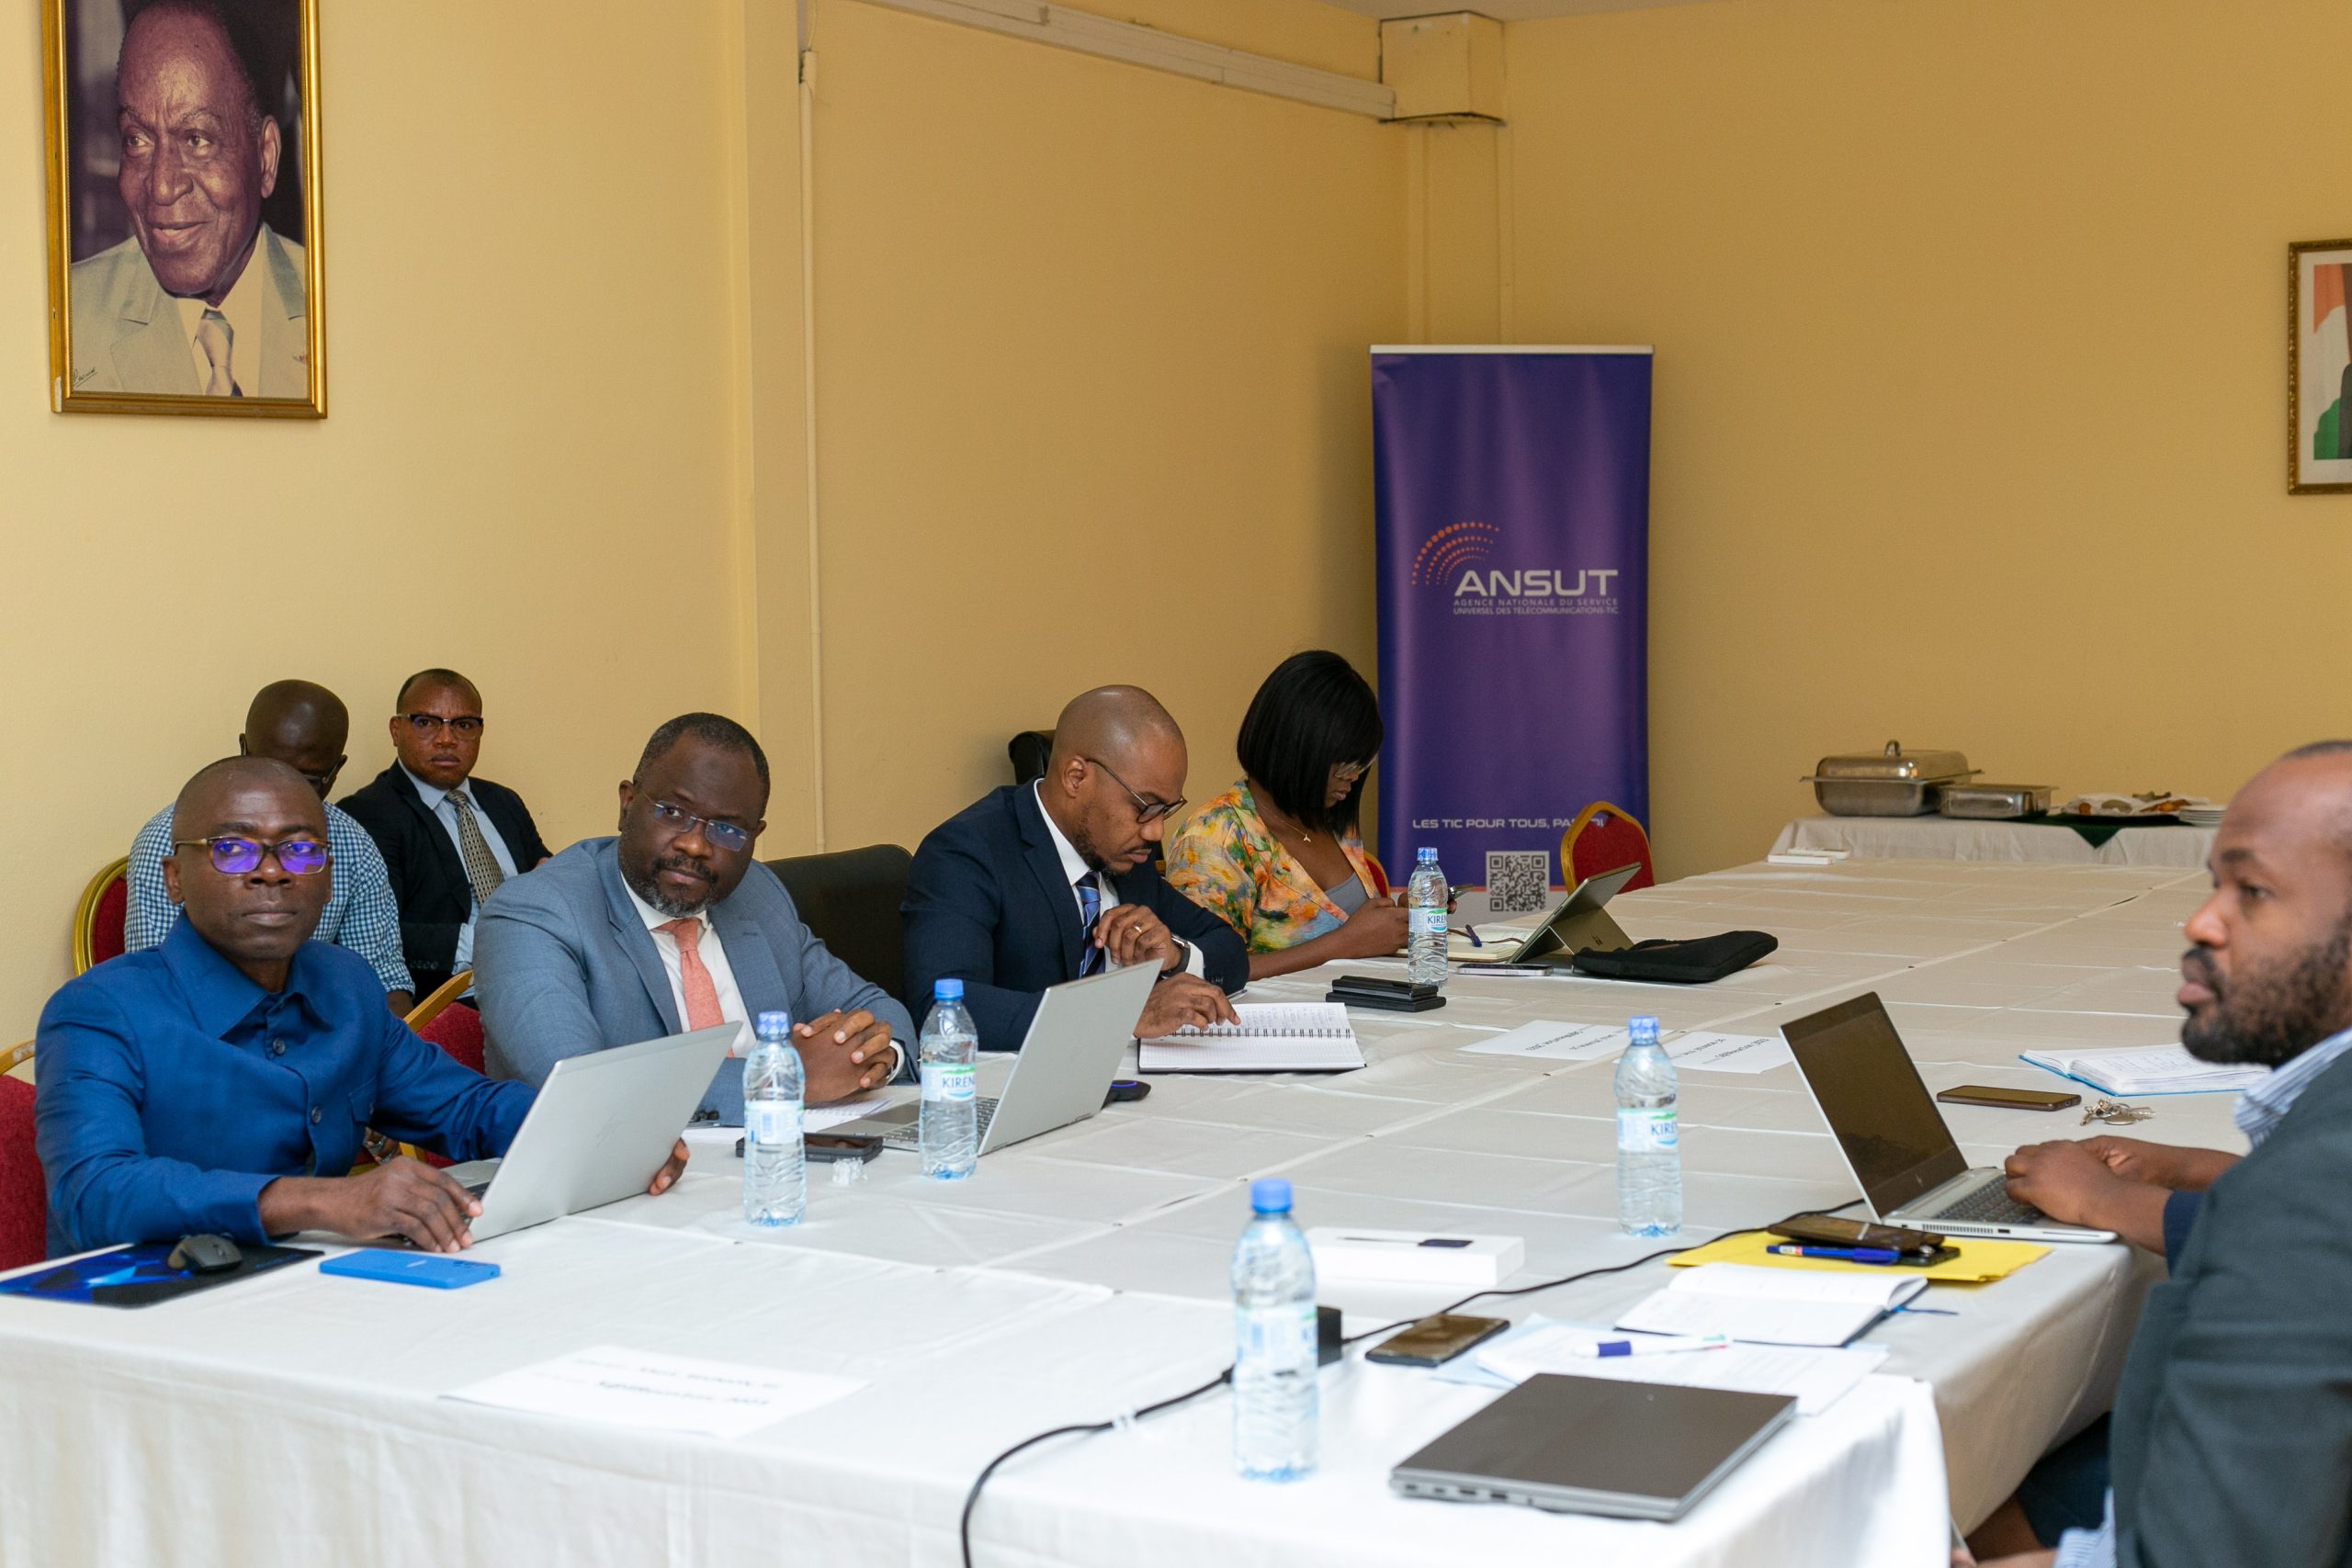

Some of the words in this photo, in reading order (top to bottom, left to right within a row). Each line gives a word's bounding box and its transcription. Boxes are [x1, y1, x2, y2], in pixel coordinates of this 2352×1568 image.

[1454, 570, 1619, 597] ANSUT
[1453, 598, 1494, 606] AGENCE
[1498, 598, 1555, 606] NATIONALE
[1559, 598, 1573, 606] DU
[1577, 598, 1618, 606] SERVICE
[1413, 819, 1439, 829] LES
[1442, 819, 1463, 828] TIC
[1466, 818, 1505, 828] POUR
[1509, 818, 1550, 829] TOUS,
